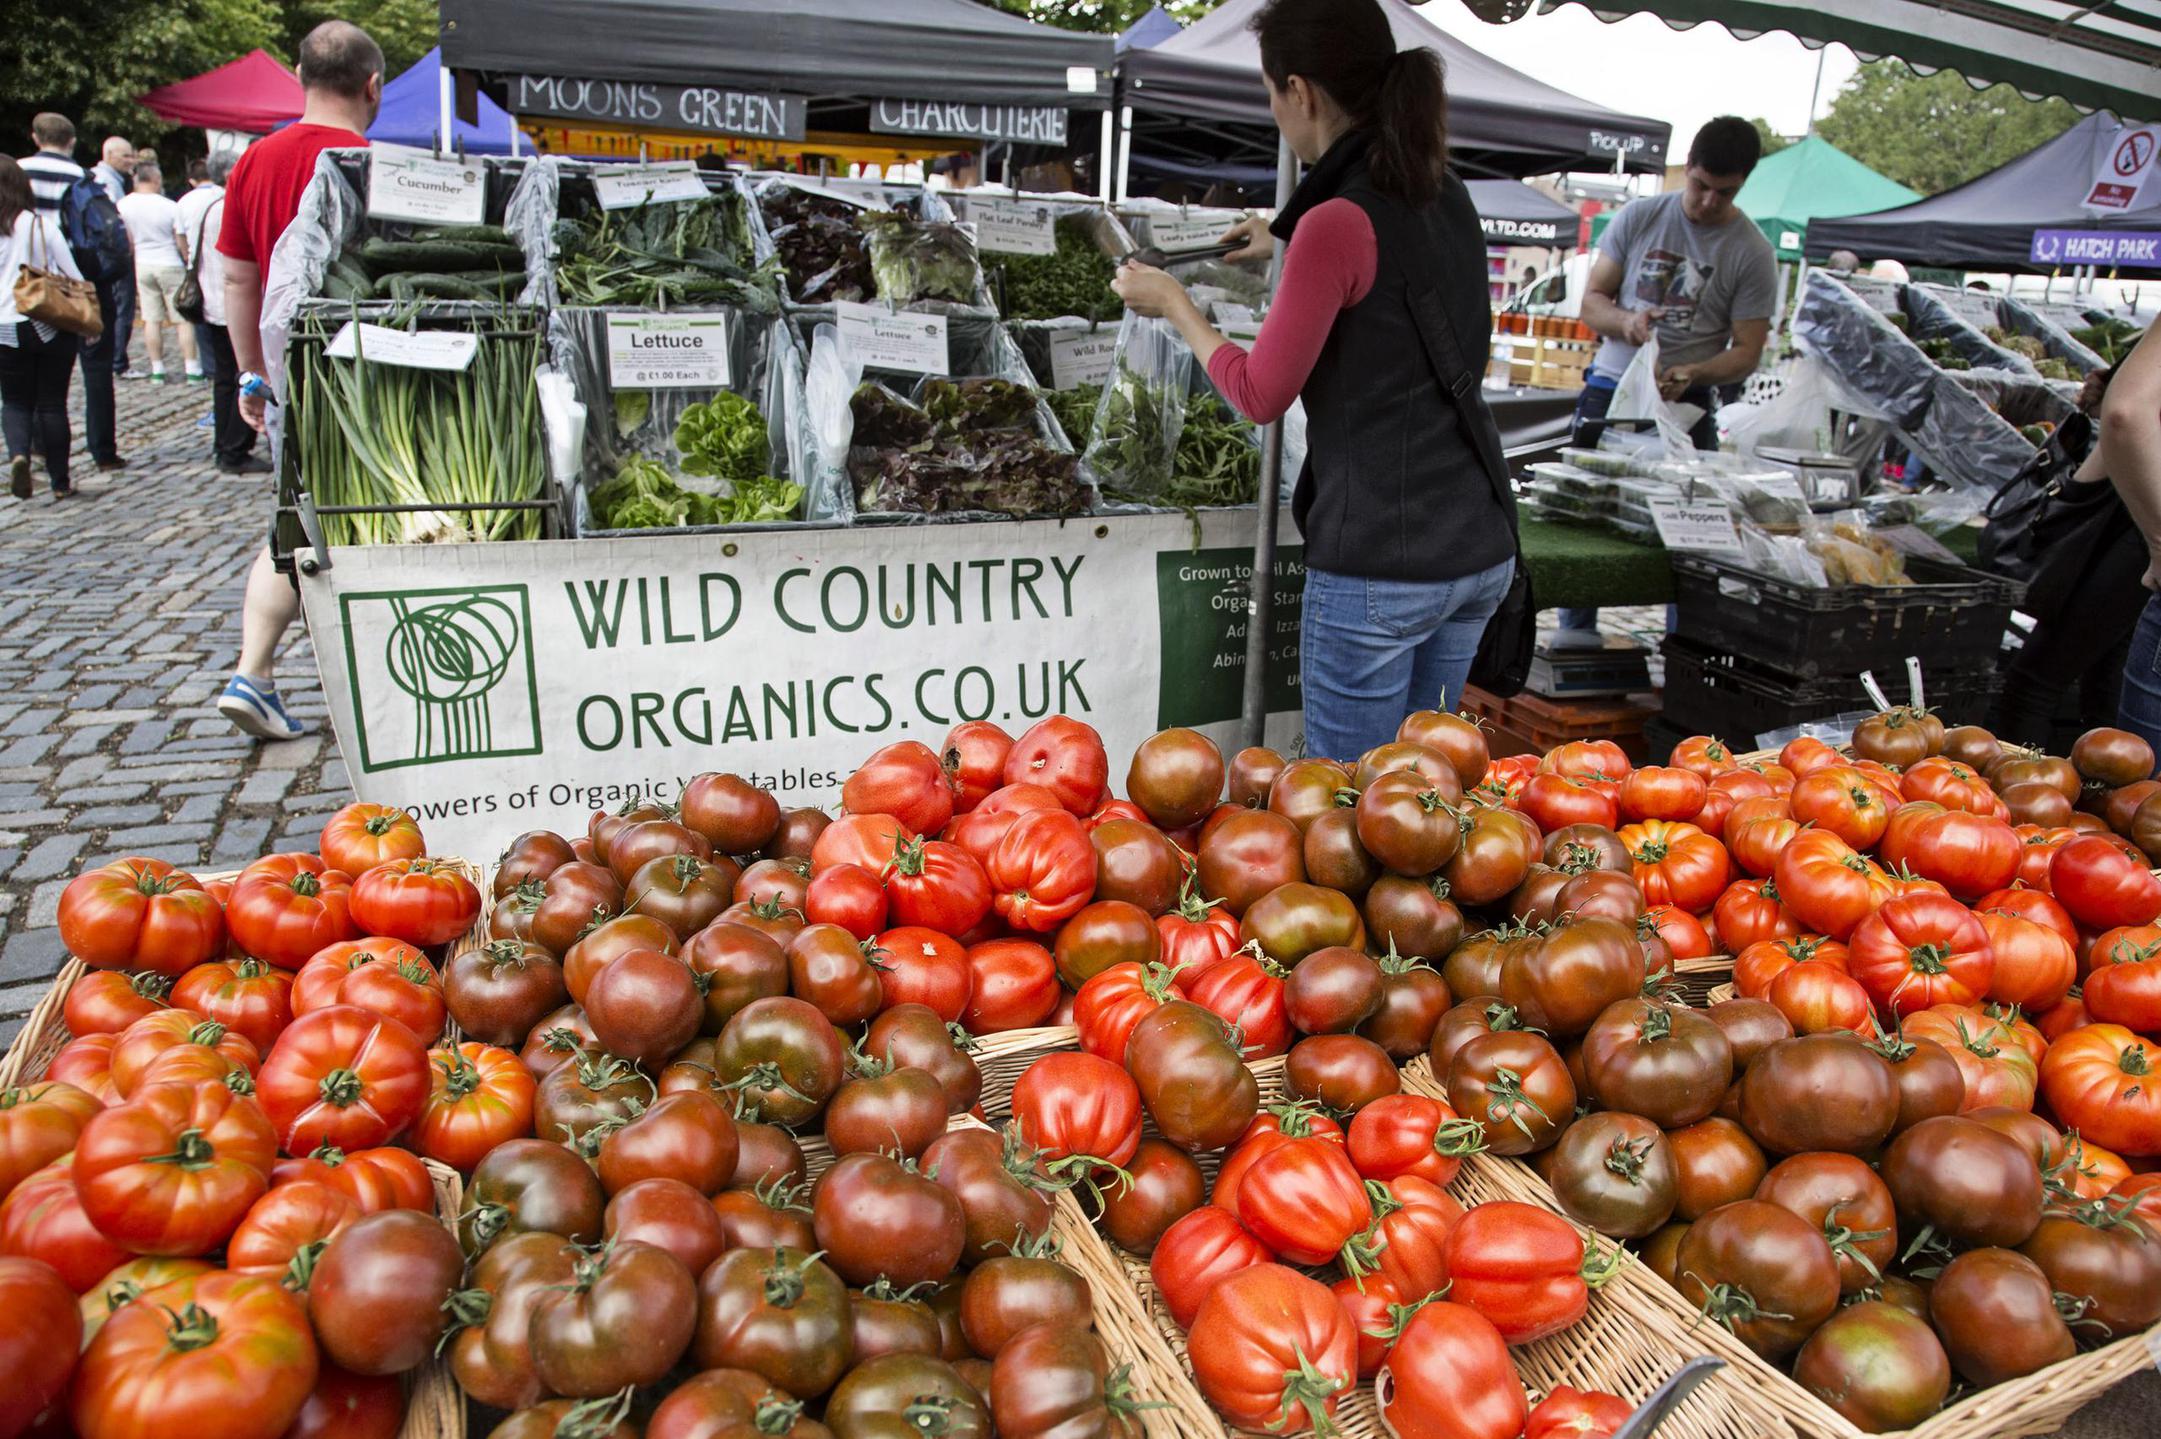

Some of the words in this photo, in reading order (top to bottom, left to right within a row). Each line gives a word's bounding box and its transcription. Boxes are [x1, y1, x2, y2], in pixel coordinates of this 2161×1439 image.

[519, 75, 663, 120] MOONS
[679, 88, 786, 136] GREEN
[397, 176, 463, 195] Cucumber
[2064, 237, 2114, 260] HATCH
[2116, 239, 2158, 261] PARK
[631, 333, 703, 348] Lettuce
[875, 328, 912, 340] Lettuce
[677, 370, 700, 380] Each
[1679, 510, 1727, 523] Peppers
[1179, 566, 1231, 582] Grown
[1235, 564, 1251, 578] to
[565, 572, 743, 650] WILD
[774, 554, 1086, 634] COUNTRY
[1211, 594, 1248, 614] Orga
[1276, 620, 1300, 633] Izza
[576, 658, 1093, 752] ORGANICS.CO.UK
[404, 794, 498, 821] owers
[508, 785, 539, 809] of
[549, 777, 667, 810] Organic
